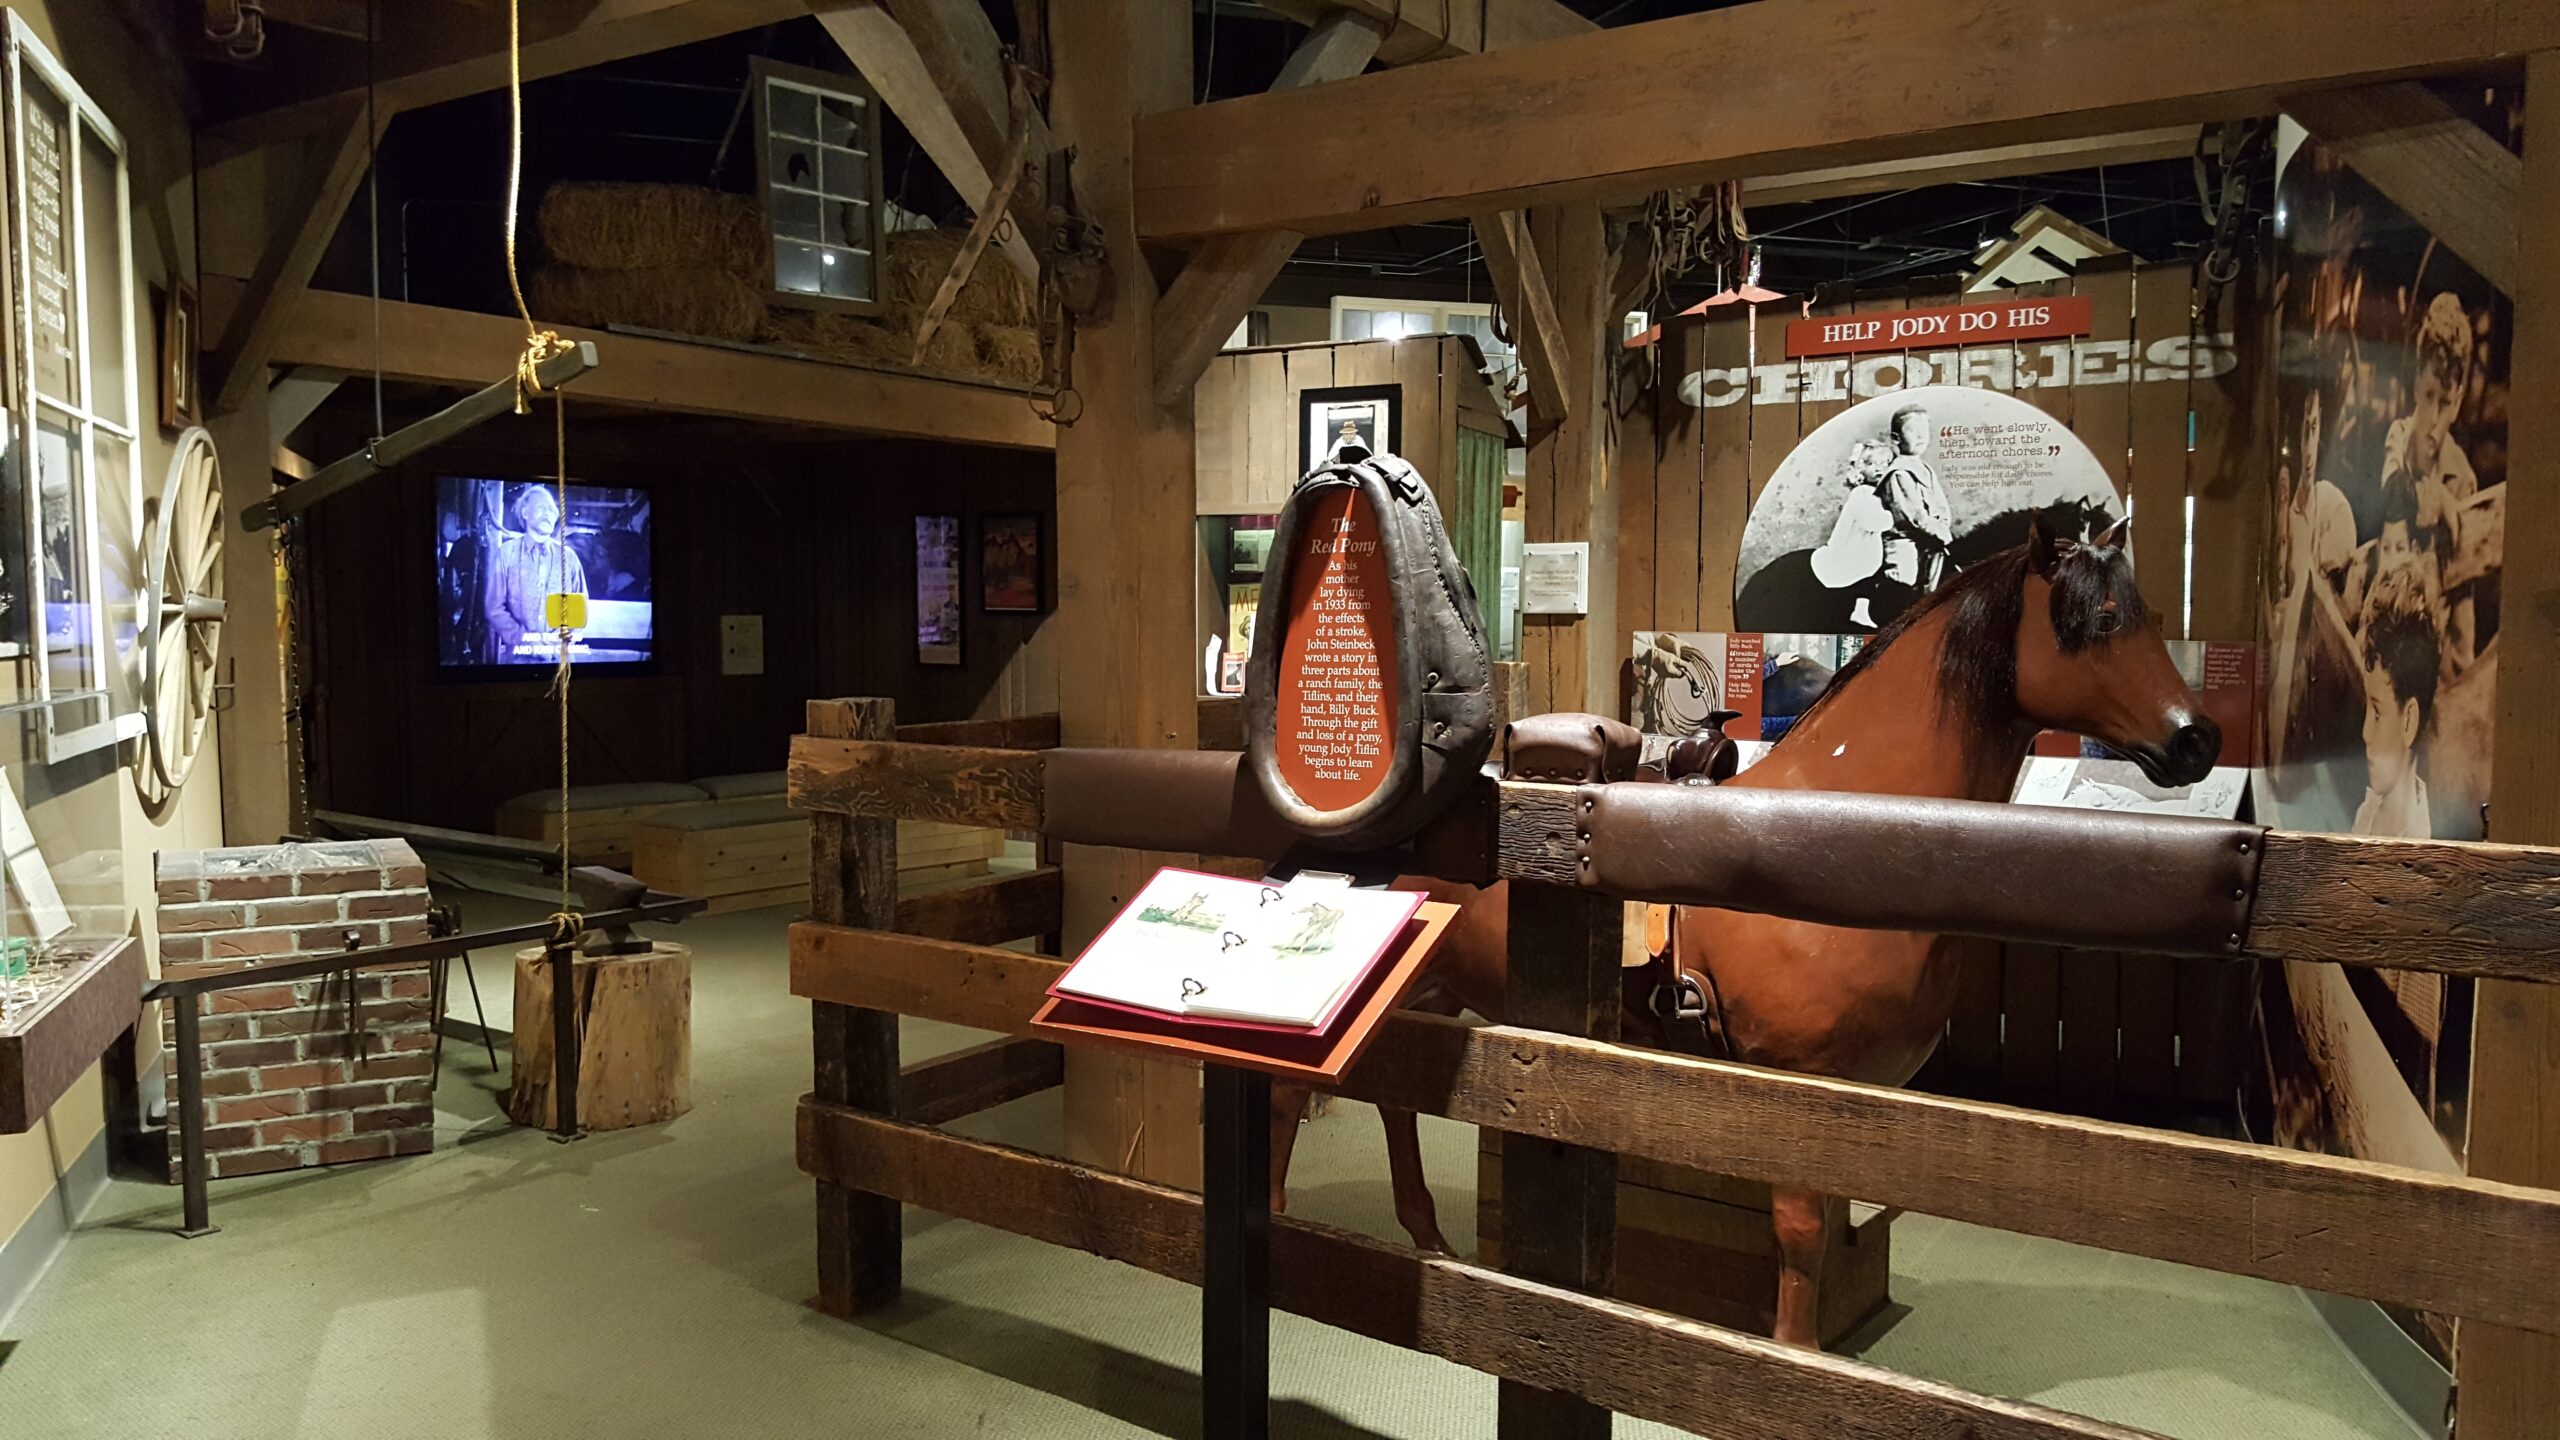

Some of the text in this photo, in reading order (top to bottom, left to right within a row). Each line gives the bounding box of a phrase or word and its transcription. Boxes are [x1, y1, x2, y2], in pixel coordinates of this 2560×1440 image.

[1822, 306, 2050, 343] HELP JODY DO HIS
[1677, 332, 2238, 408] CHORES
[1940, 421, 2051, 437] “He went slowly,
[1973, 435, 2016, 446] toward
[2021, 434, 2041, 444] the
[1939, 445, 2061, 460] afternoon chores.”
[1331, 517, 1356, 533] The
[1310, 538, 1377, 557] Red Pony
[1328, 560, 1358, 571] As his
[1325, 573, 1360, 584] mother
[1320, 586, 1364, 600] lay dying
[1313, 599, 1371, 610] in 1933 from
[1318, 613, 1365, 623] the effects
[1315, 626, 1367, 637] of a stroke,
[1306, 639, 1375, 651] John Steinbeck
[1304, 652, 1377, 665] wrote a story in
[1301, 664, 1380, 679] three parts about
[1298, 678, 1383, 691] a ranch family, the
[1302, 690, 1378, 702] Tiflins, and their
[1300, 703, 1379, 717] hand, Billy Buck.
[1302, 716, 1378, 731] Through the gift
[1296, 729, 1382, 745] and loss of a pony,
[1299, 743, 1380, 757] young Jody Tiflin
[1304, 755, 1373, 768] begins to learn
[1315, 768, 1361, 780] about life.
